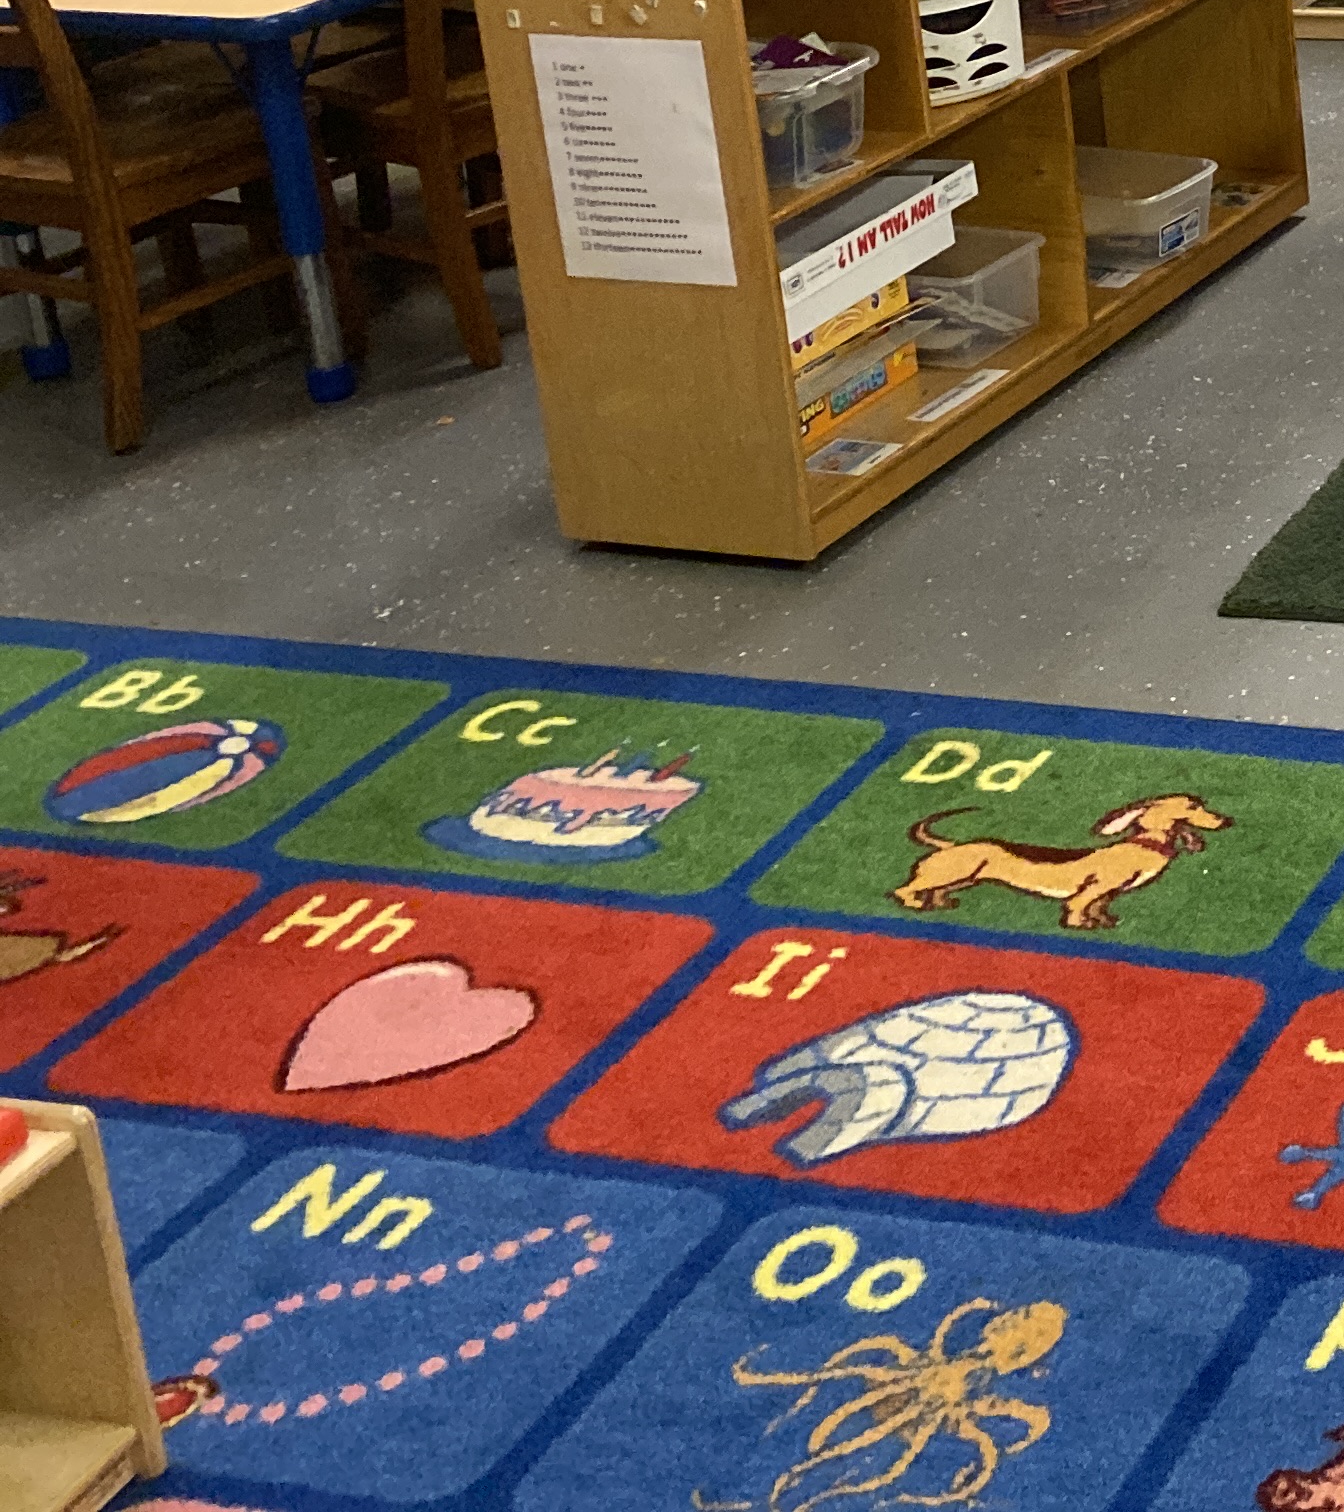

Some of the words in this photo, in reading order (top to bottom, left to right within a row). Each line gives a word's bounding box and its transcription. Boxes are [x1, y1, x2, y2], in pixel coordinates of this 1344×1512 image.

[878, 210, 908, 244] TALL
[910, 193, 936, 223] HOW
[856, 227, 877, 257] AM
[78, 668, 205, 715] Bb
[460, 698, 574, 746] Cc
[900, 738, 1053, 793] Dd
[265, 895, 414, 953] Hh
[732, 940, 847, 1000] Ii
[254, 1165, 431, 1245] Nn
[753, 1226, 924, 1310] Oo
